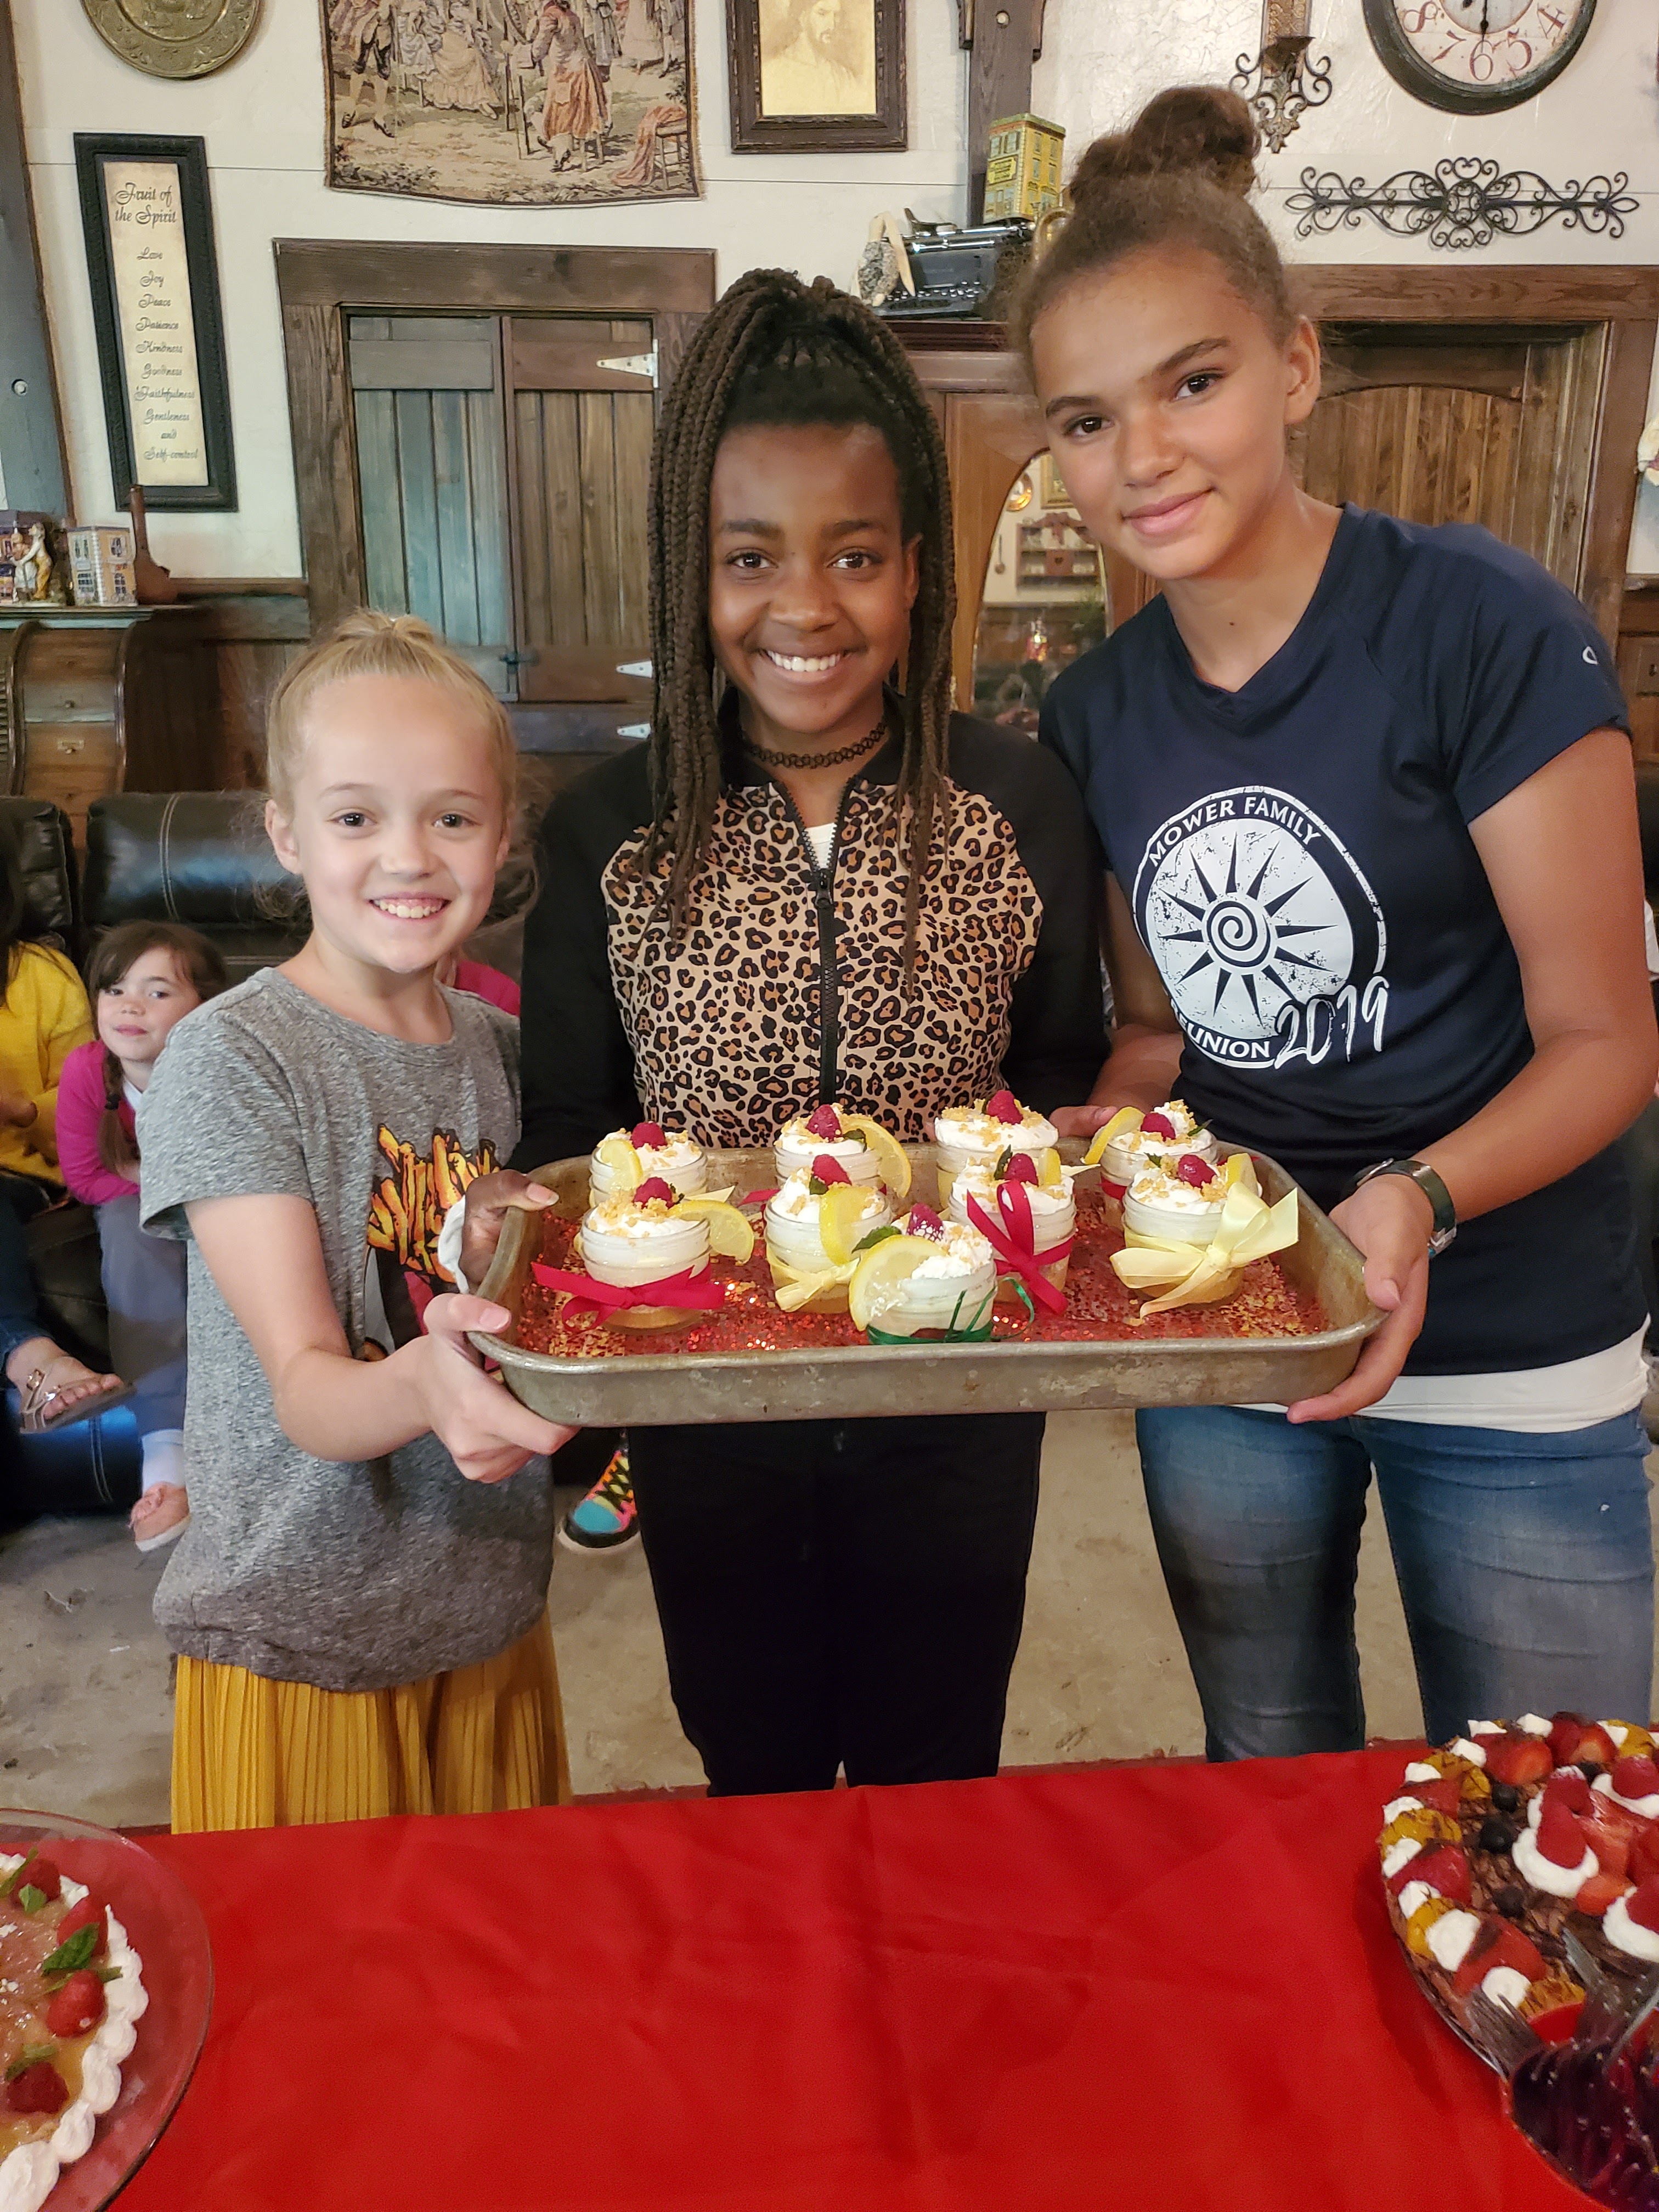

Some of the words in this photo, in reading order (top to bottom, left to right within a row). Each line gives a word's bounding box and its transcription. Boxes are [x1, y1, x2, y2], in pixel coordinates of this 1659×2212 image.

[1402, 2, 1438, 33] 8
[1537, 7, 1566, 40] 4
[1431, 30, 1467, 64] 7
[1469, 40, 1497, 81] 6
[115, 182, 156, 205] Fruit
[160, 185, 172, 207] of
[115, 206, 132, 222] the
[136, 204, 176, 229] Spirit
[137, 246, 162, 260] Love
[139, 270, 164, 288] Joy
[138, 294, 171, 308] Peace
[135, 317, 179, 331] Patience
[135, 340, 183, 353] Kindness
[141, 363, 183, 379] Goodness
[133, 386, 195, 402] Faithfulness
[143, 408, 190, 424] Gentleness
[160, 429, 177, 439] and
[1149, 799, 1236, 867] MOWER
[1244, 796, 1322, 845] FAMILY
[1274, 975, 1390, 1070] 2019
